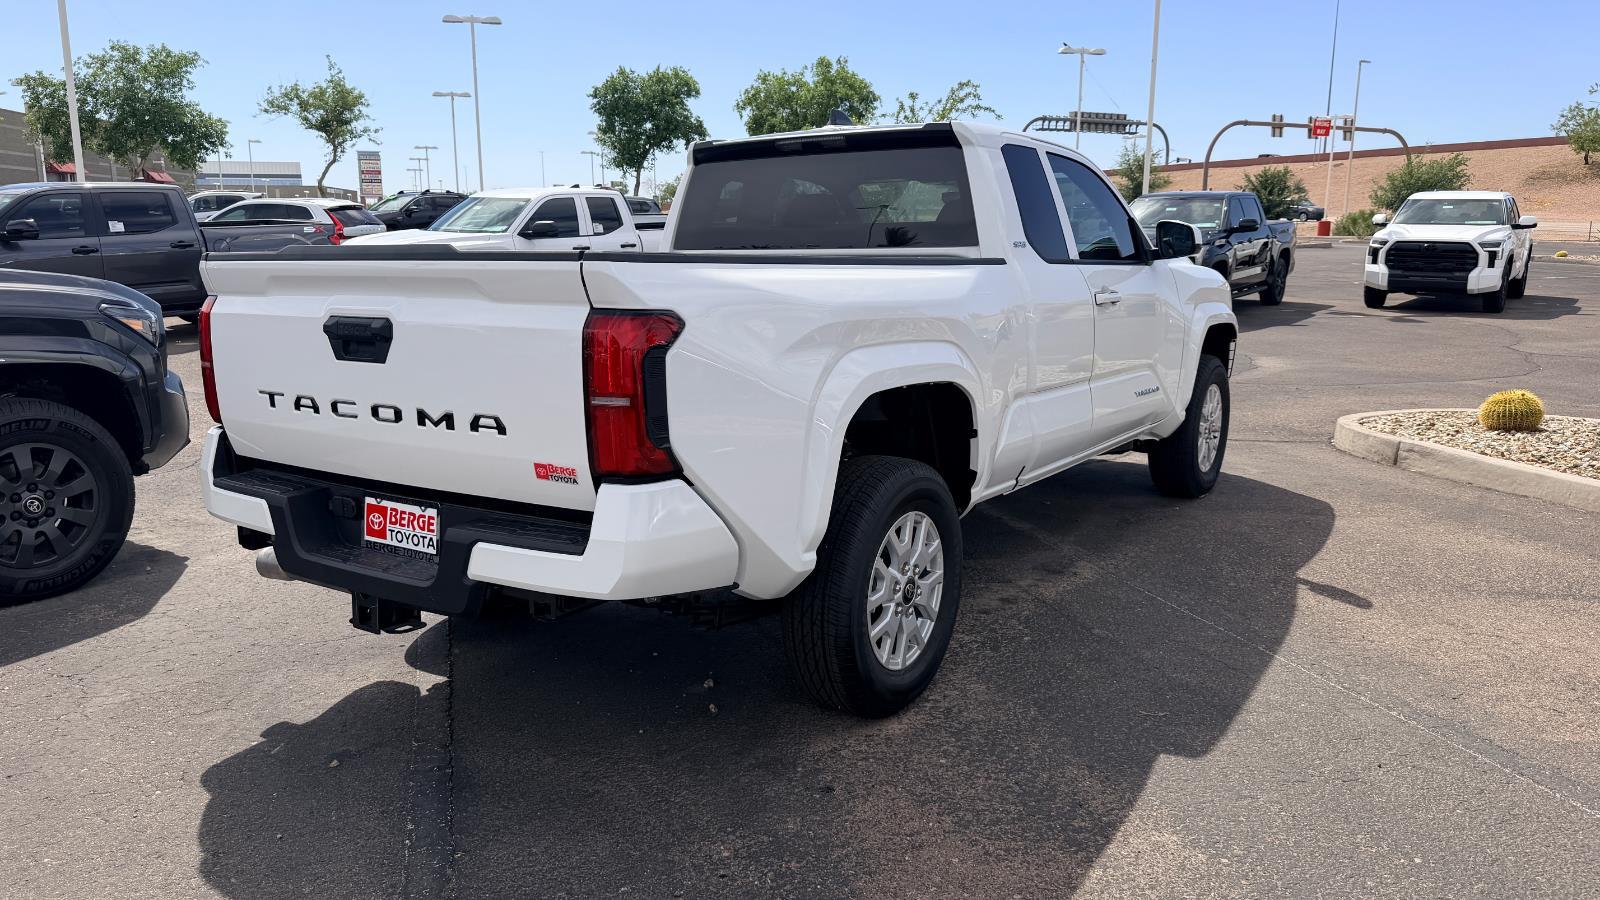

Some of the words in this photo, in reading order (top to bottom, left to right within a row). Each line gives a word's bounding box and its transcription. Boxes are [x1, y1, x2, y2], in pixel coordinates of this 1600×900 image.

[258, 389, 507, 436] TACOMA
[548, 464, 577, 476] BERGE
[549, 474, 578, 484] TOYOTA
[388, 507, 435, 533] BERGE
[388, 528, 436, 550] TOYOTA
[366, 541, 399, 555] BERGE
[400, 547, 435, 562] TOYOTA
